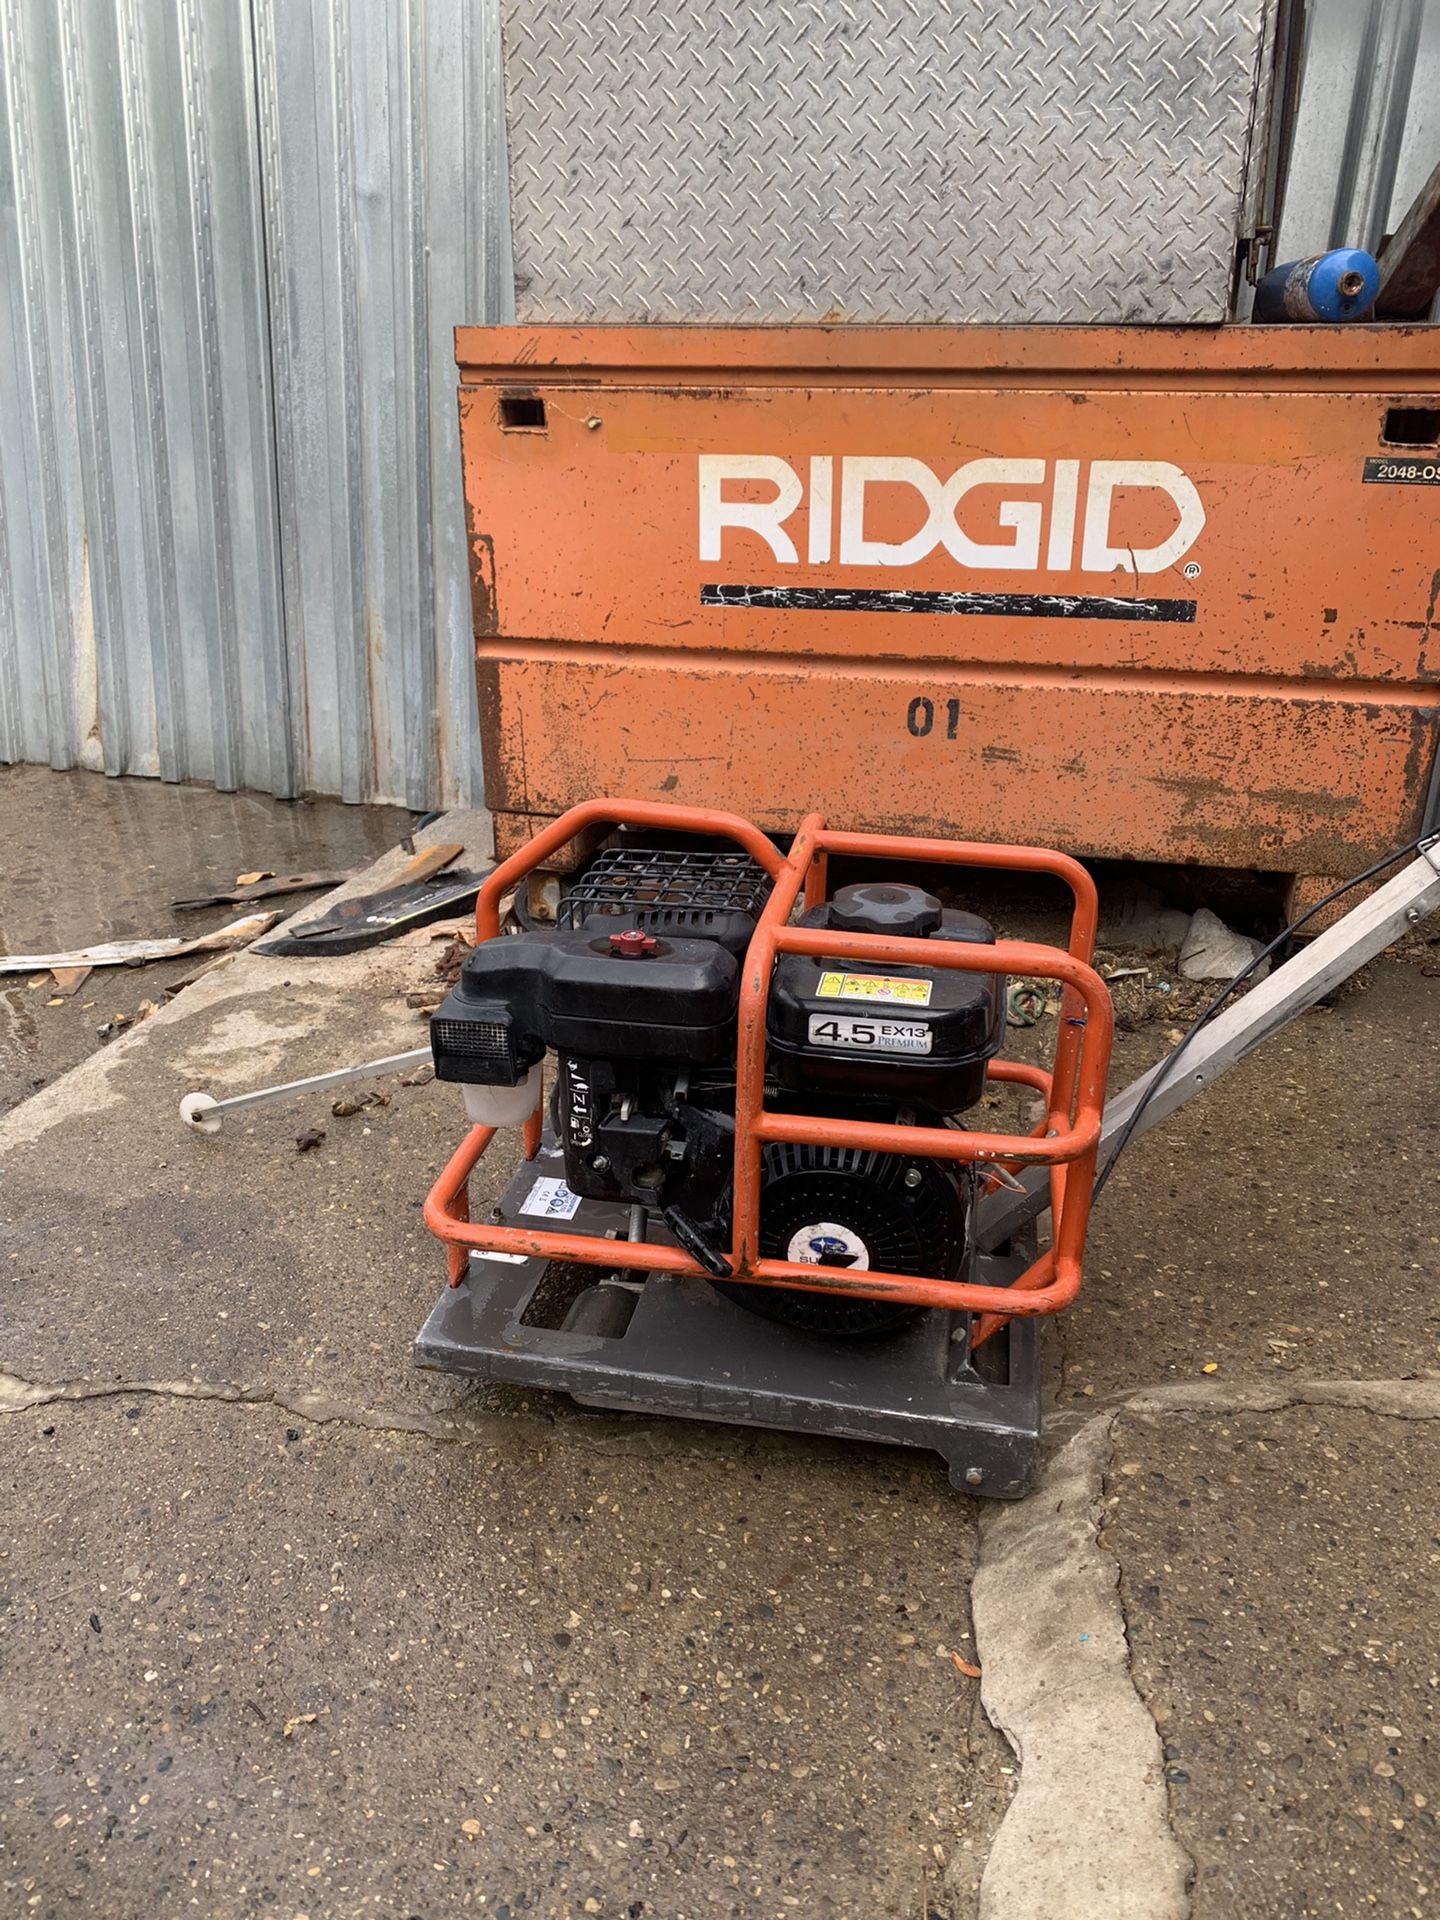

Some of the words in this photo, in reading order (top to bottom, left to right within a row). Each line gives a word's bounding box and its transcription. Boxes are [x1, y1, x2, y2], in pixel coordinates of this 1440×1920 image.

[699, 454, 1206, 573] RIDGID
[907, 696, 960, 740] 01
[814, 1021, 875, 1045] 4.5
[881, 1025, 926, 1038] EX13
[878, 1035, 928, 1049] PREMIUM
